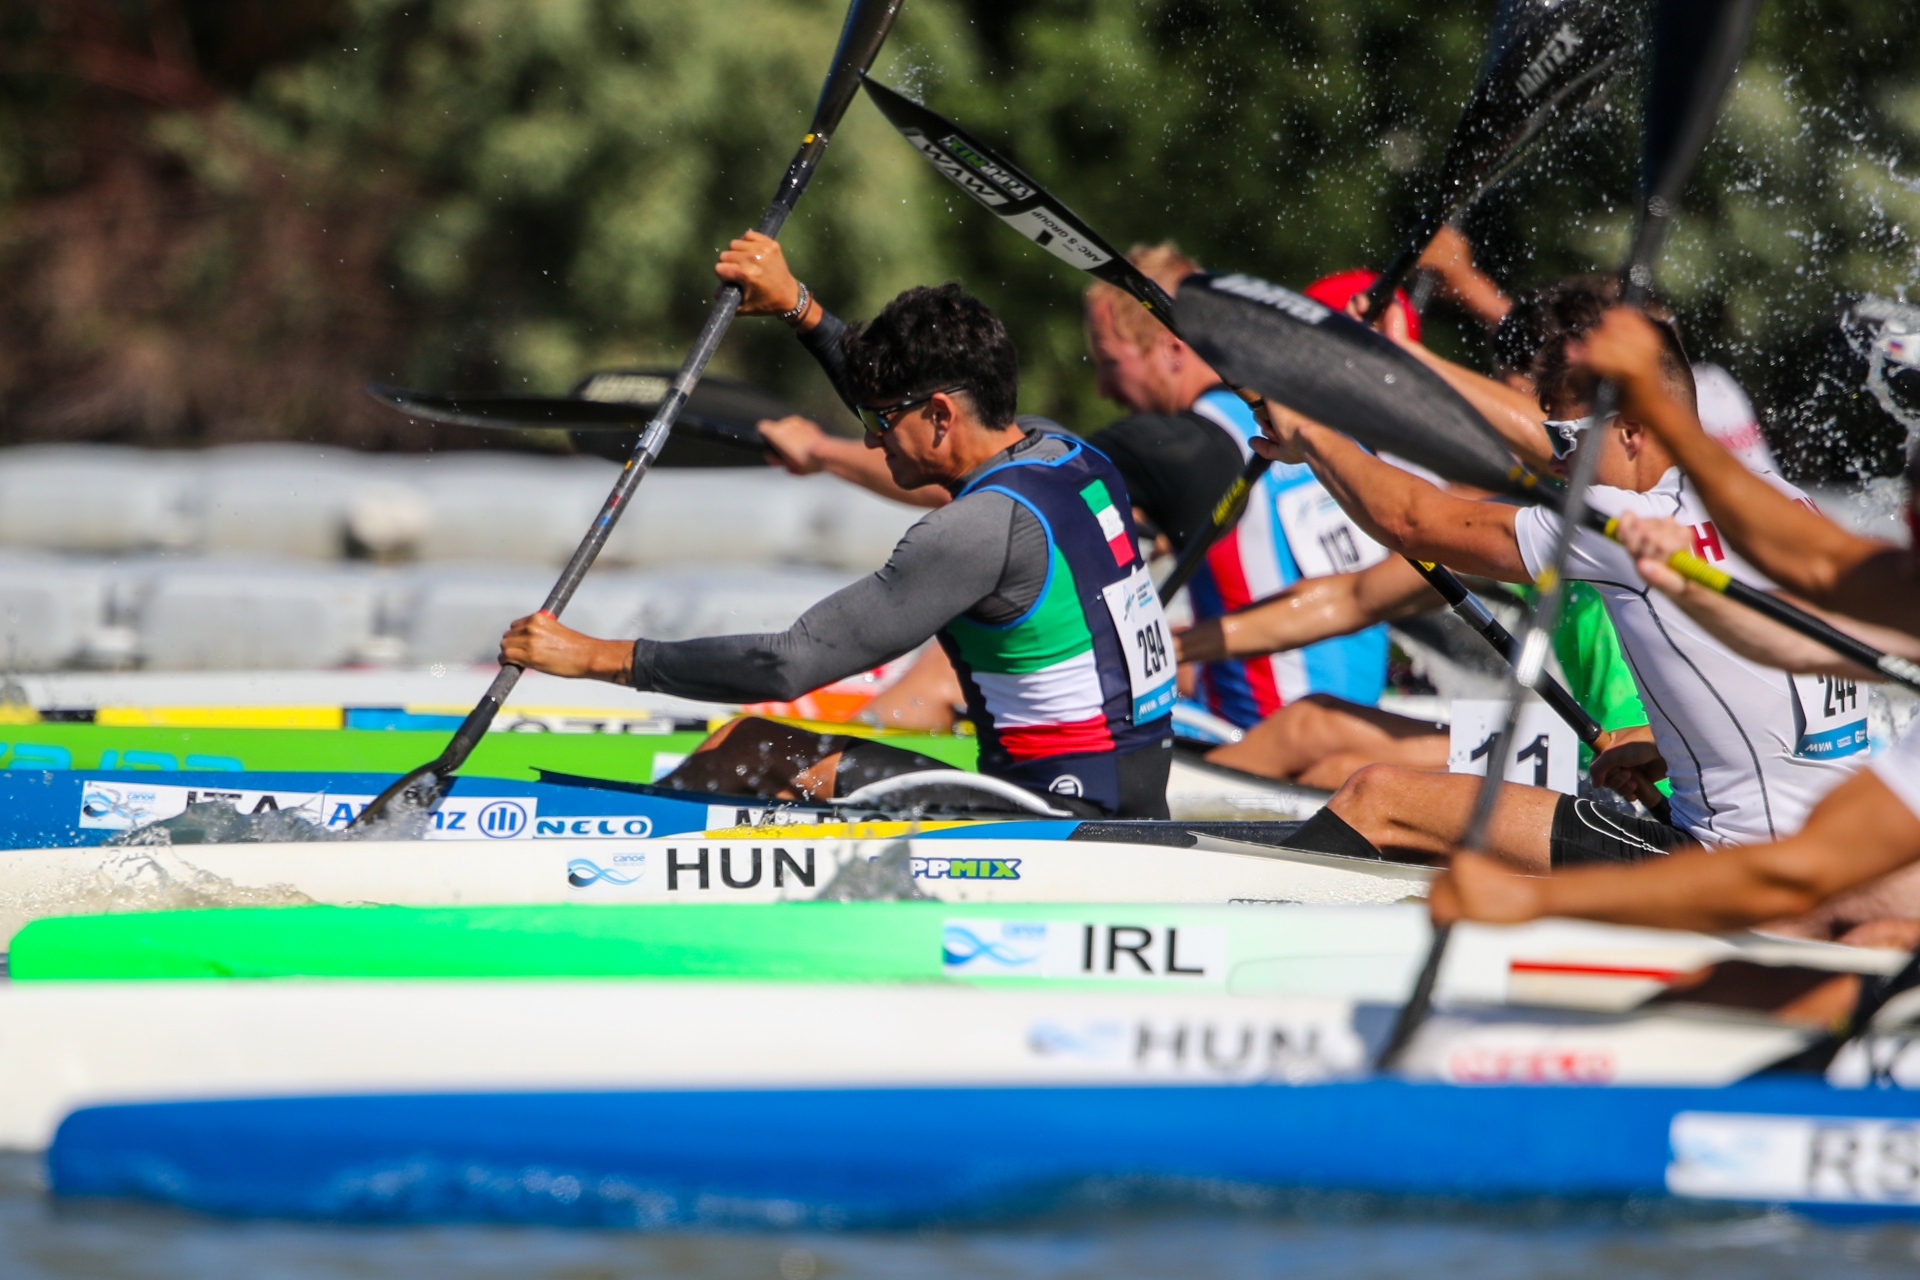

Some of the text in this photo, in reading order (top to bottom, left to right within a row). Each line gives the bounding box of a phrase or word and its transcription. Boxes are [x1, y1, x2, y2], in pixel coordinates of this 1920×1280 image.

[1031, 211, 1069, 239] GROUP
[1136, 618, 1168, 679] 294
[1817, 674, 1857, 718] 244
[1805, 741, 1833, 752] MVM
[536, 820, 648, 834] NELO
[666, 847, 816, 890] HUN
[1082, 924, 1204, 976] IRL
[1134, 1021, 1320, 1073] HUN
